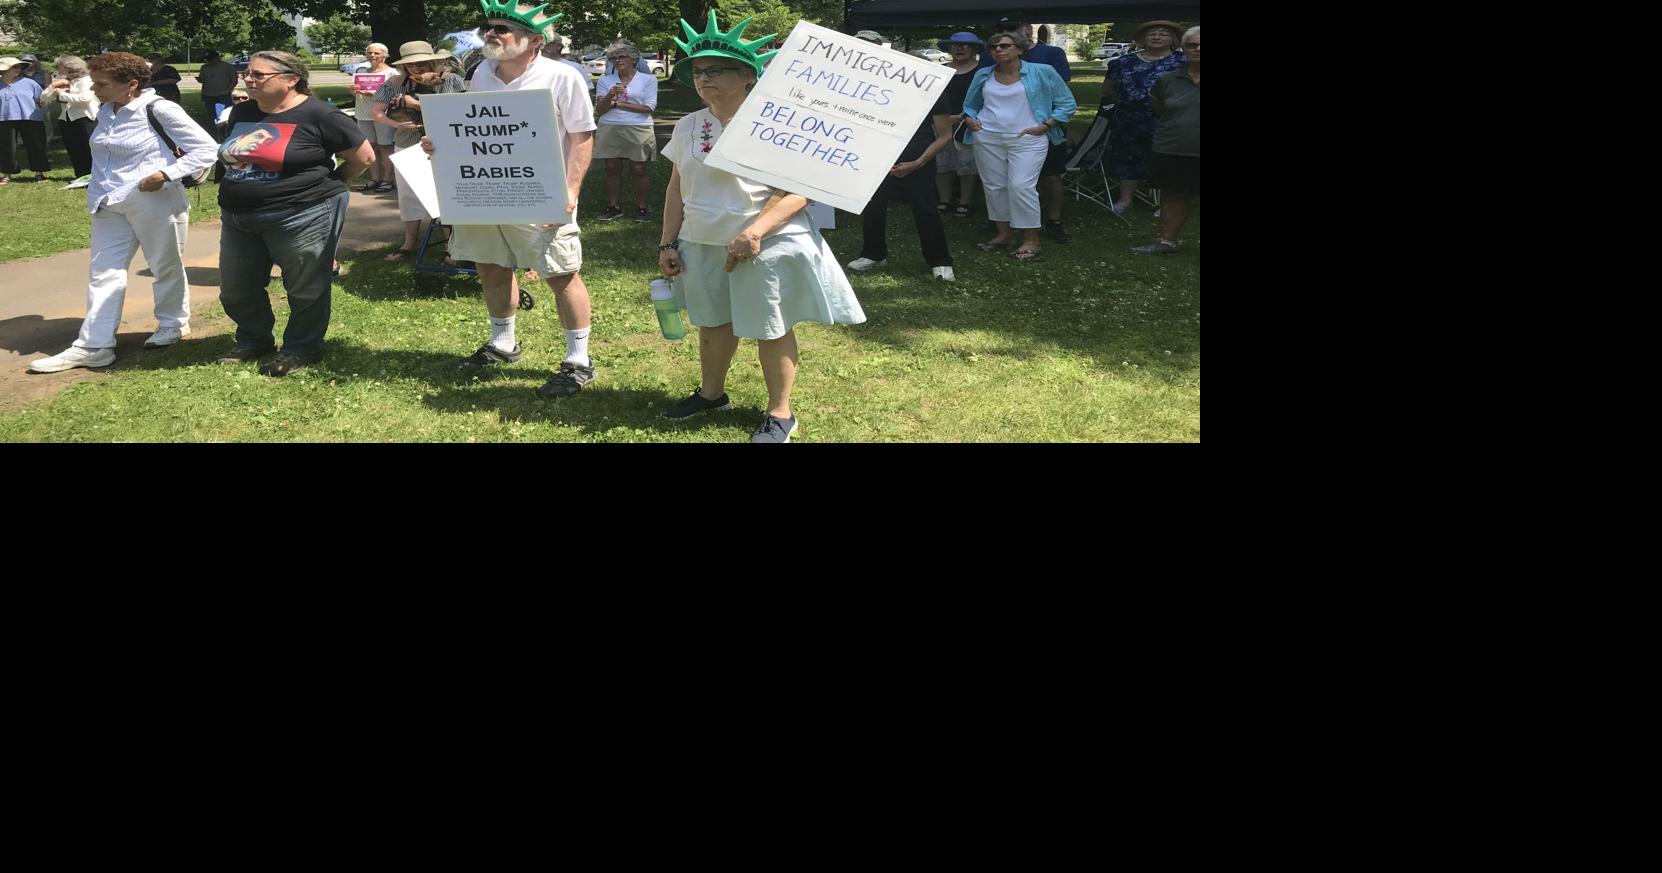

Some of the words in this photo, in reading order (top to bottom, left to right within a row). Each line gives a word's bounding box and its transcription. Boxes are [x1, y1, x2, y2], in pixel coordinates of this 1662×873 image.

[784, 59, 894, 106] FAMILIES
[798, 34, 942, 92] IMMIGRANT
[465, 104, 510, 118] JAIL
[760, 101, 855, 144] BELONG
[788, 87, 806, 101] like
[809, 98, 830, 107] yours
[839, 105, 859, 116] mine
[858, 112, 876, 122] once
[877, 119, 897, 128] were
[471, 141, 515, 155] NOT
[750, 121, 860, 171] TOGETHER
[460, 165, 535, 179] BABIES
